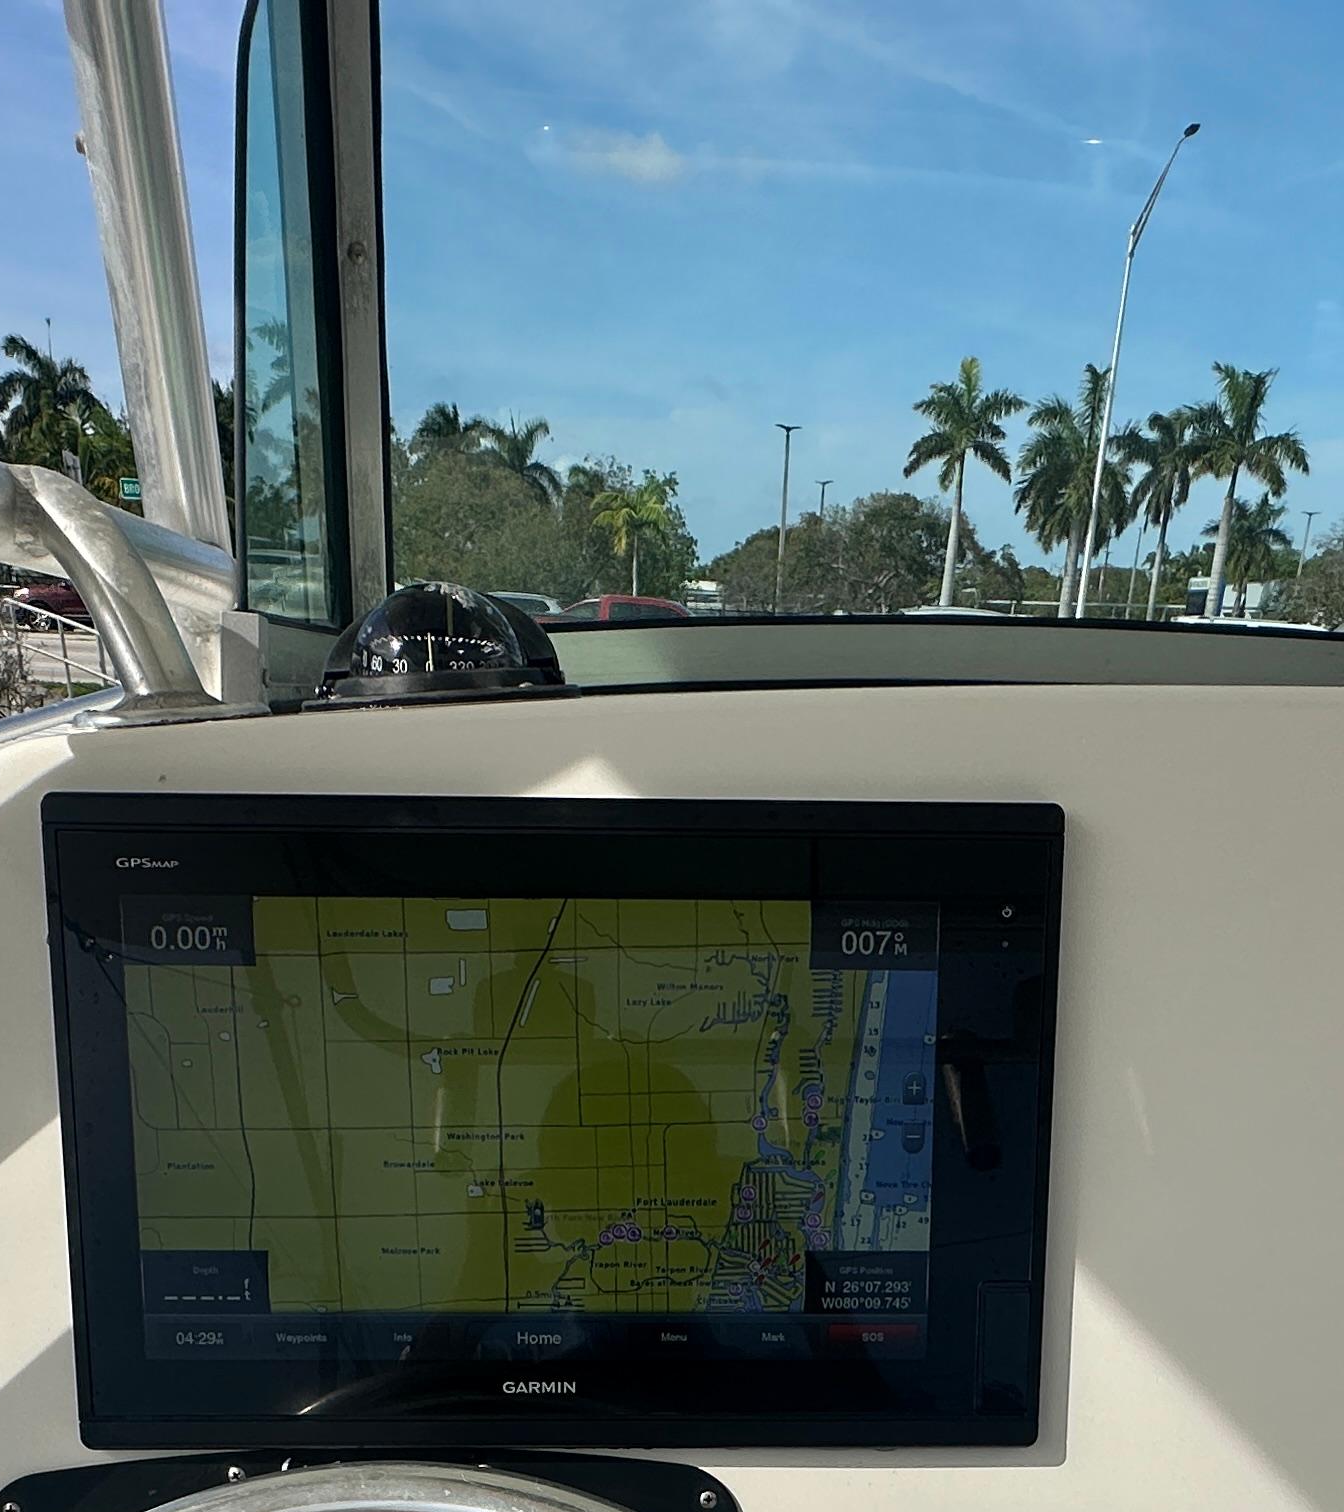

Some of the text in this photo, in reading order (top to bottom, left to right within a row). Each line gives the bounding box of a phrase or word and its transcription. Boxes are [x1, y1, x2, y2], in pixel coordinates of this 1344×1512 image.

[392, 659, 408, 674] 30
[115, 857, 180, 869] GPSMAP
[151, 926, 210, 951] 0.00
[841, 930, 891, 955] 007
[636, 1197, 717, 1207] Fort Lauderdale
[825, 1281, 836, 1293] N
[275, 1332, 327, 1344] Waypoints
[517, 1331, 562, 1346] Home
[661, 1332, 687, 1343] Menu
[761, 1332, 785, 1343] Mark
[861, 1333, 884, 1343] SOS
[503, 1381, 576, 1394] GARMIN
